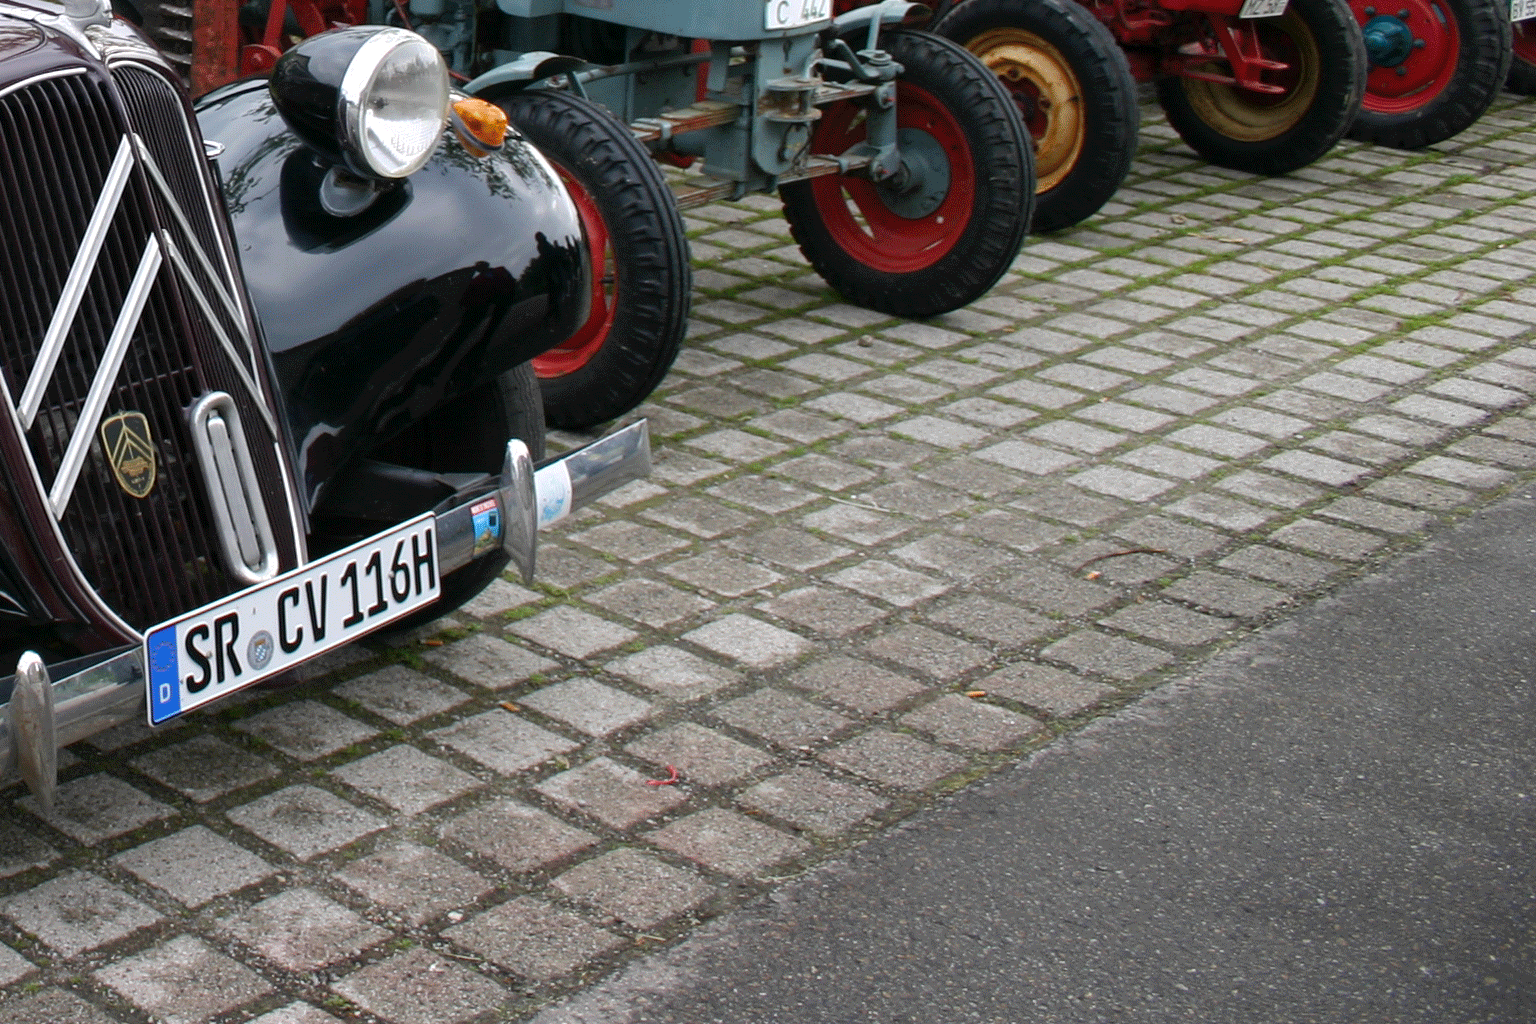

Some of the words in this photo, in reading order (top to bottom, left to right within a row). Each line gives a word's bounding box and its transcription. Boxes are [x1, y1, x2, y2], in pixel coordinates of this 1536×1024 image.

[777, 0, 789, 24] C
[159, 682, 171, 704] D
[185, 612, 242, 694] SR
[277, 573, 328, 654] CV
[340, 527, 436, 629] 116H
